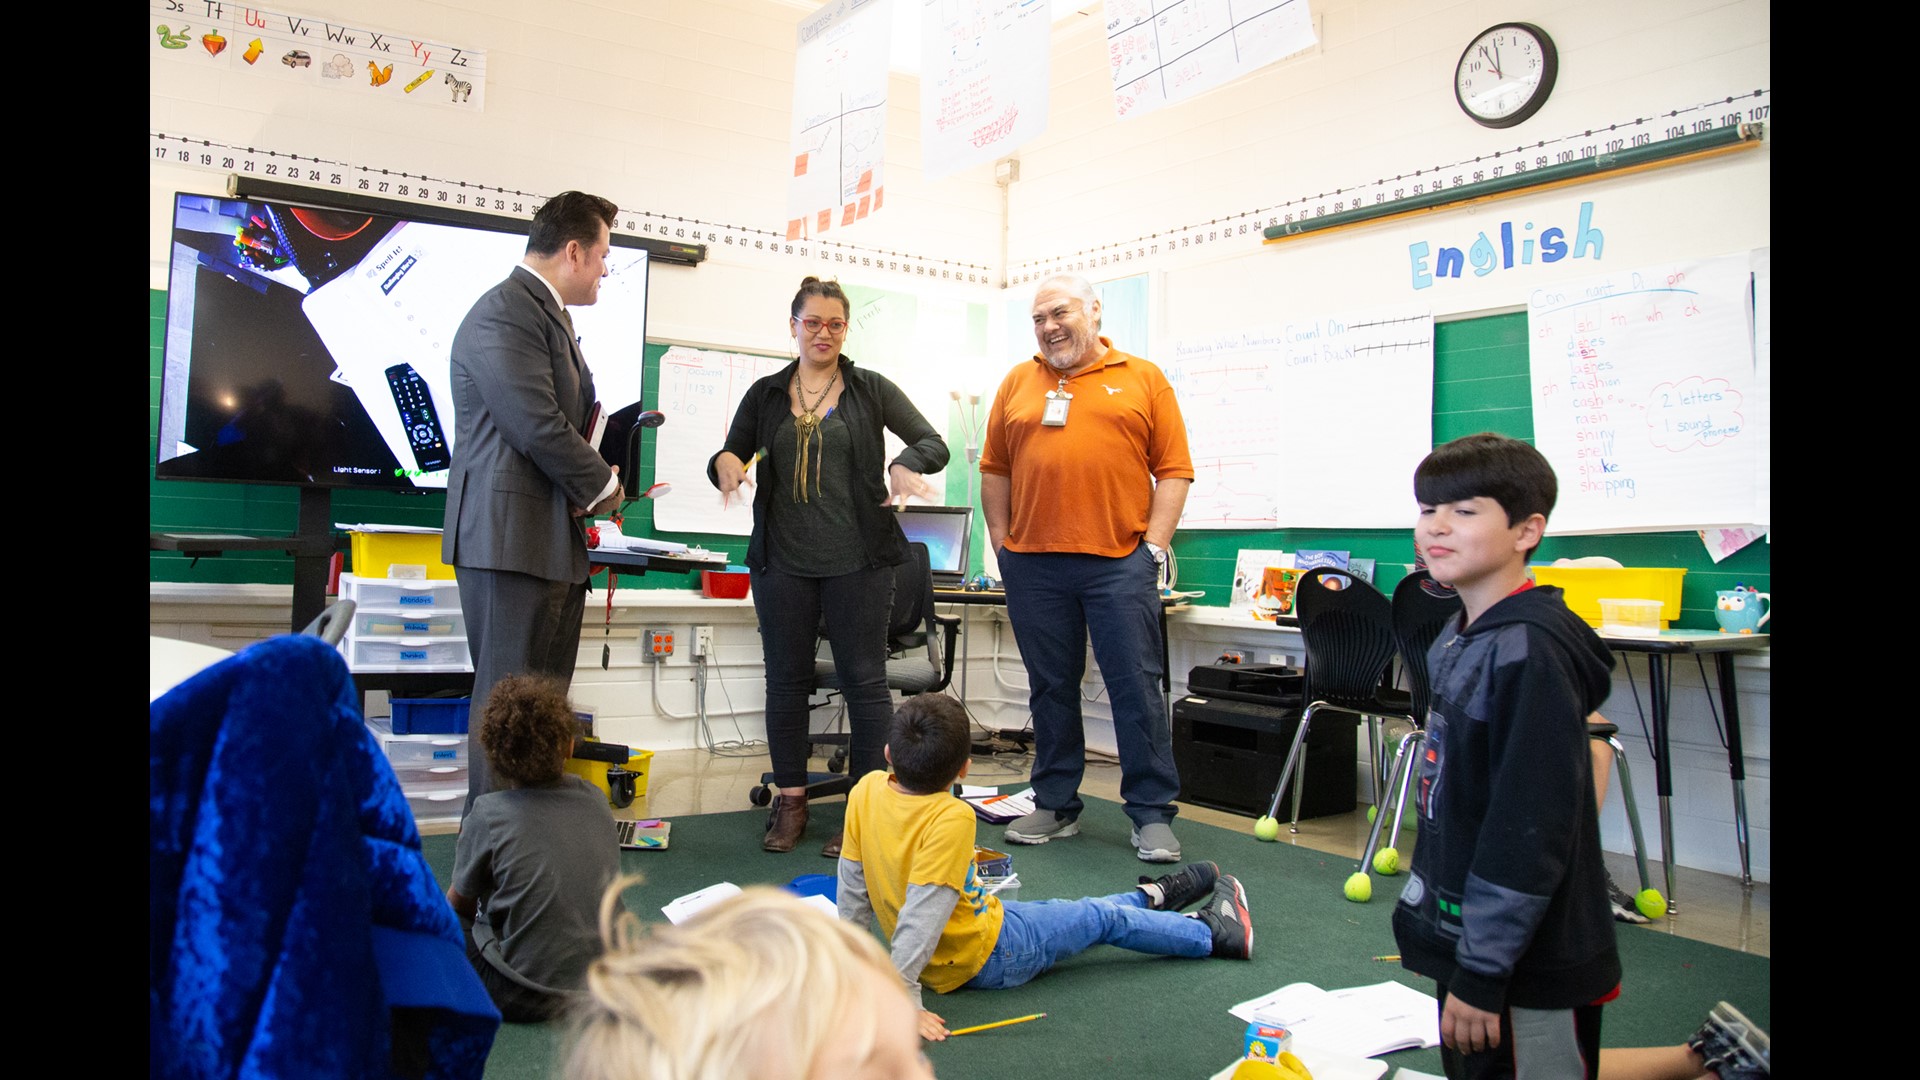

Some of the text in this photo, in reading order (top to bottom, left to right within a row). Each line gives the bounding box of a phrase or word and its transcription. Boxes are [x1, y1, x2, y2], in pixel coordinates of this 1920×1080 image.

[205, 0, 223, 20] Tt
[245, 9, 266, 29] Uu
[287, 17, 309, 37] Vv
[325, 23, 355, 46] Ww
[370, 32, 391, 53] Xx
[410, 40, 432, 66] Yy
[450, 48, 468, 67] Zz
[1492, 35, 1504, 48] 12
[1513, 36, 1517, 46] 1
[1523, 44, 1531, 55] 2
[1469, 60, 1481, 73] 10
[1528, 58, 1536, 69] 3
[1465, 78, 1472, 89] 9
[1169, 241, 1175, 250] 78
[1182, 238, 1189, 247] 79
[1195, 235, 1203, 244] 80
[1209, 232, 1216, 241] 81
[1224, 228, 1232, 238] 82
[1239, 225, 1247, 234] 83
[1253, 221, 1262, 232] 84
[1269, 217, 1278, 227] 85
[1284, 213, 1293, 224] 86
[1300, 209, 1308, 220] 87
[1316, 205, 1325, 217] 88
[1334, 202, 1343, 213] 89
[1352, 198, 1361, 209] 90
[1376, 193, 1385, 203] 91
[1394, 188, 1404, 200] 92
[1413, 184, 1423, 196] 93
[1432, 180, 1442, 192] 94
[1453, 175, 1463, 187] 95
[1473, 170, 1484, 183] 96
[1493, 166, 1503, 178] 97
[1515, 160, 1526, 173] 98
[1536, 155, 1547, 169] 99
[1556, 150, 1574, 164] 100
[1580, 145, 1597, 158] 101
[1605, 139, 1624, 153] 102
[1631, 133, 1650, 147] 103
[1665, 125, 1685, 140] 104
[1692, 119, 1712, 134] 105
[1720, 112, 1742, 128] 106
[1748, 105, 1770, 121] 107
[156, 147, 166, 158] 17
[179, 151, 189, 161] 18
[201, 154, 211, 165] 19
[223, 157, 234, 168] 20
[244, 161, 254, 171] 21
[266, 164, 277, 175] 22
[288, 167, 298, 178] 23
[310, 171, 320, 181] 24
[331, 174, 341, 184] 25
[359, 179, 369, 189] 26
[379, 182, 389, 192] 27
[398, 185, 408, 195] 28
[419, 188, 428, 198] 29
[437, 191, 447, 201] 30
[457, 194, 465, 204] 31
[476, 197, 485, 207] 32
[495, 200, 504, 210] 33
[513, 203, 522, 212] 34
[626, 221, 635, 230] 40
[643, 224, 651, 232] 41
[659, 226, 668, 235] 42
[676, 229, 685, 238] 43
[692, 230, 701, 240] 44
[707, 233, 716, 243] 45
[724, 236, 732, 245] 46
[740, 238, 747, 246] 47
[755, 241, 762, 249] 48
[770, 243, 778, 252] 49
[785, 245, 793, 254] 50
[801, 248, 807, 256] 51
[821, 251, 828, 259] 52
[835, 253, 842, 262] 53
[849, 256, 856, 264] 54
[863, 258, 870, 266] 55
[877, 260, 884, 268] 56
[890, 262, 897, 270] 57
[1409, 201, 1604, 290] English
[1537, 320, 1554, 339] ch
[1576, 315, 1593, 333] sh
[1646, 304, 1664, 323] wh
[1683, 299, 1701, 318] ck
[1286, 318, 1345, 344] Count On
[1285, 344, 1318, 367] Count
[1570, 374, 1621, 391] fashion
[1572, 391, 1604, 410] cash
[1661, 389, 1723, 409] 2 letters
[1575, 411, 1609, 425] rash
[1677, 414, 1713, 433] sound
[1576, 428, 1616, 448] shiny
[1702, 425, 1741, 440] phoneme
[1577, 442, 1613, 459] shell
[333, 466, 352, 474] Light
[1579, 458, 1620, 476] shake
[1580, 474, 1636, 499] shopping
[1314, 552, 1323, 560] BOY
[400, 596, 432, 604] Mondays
